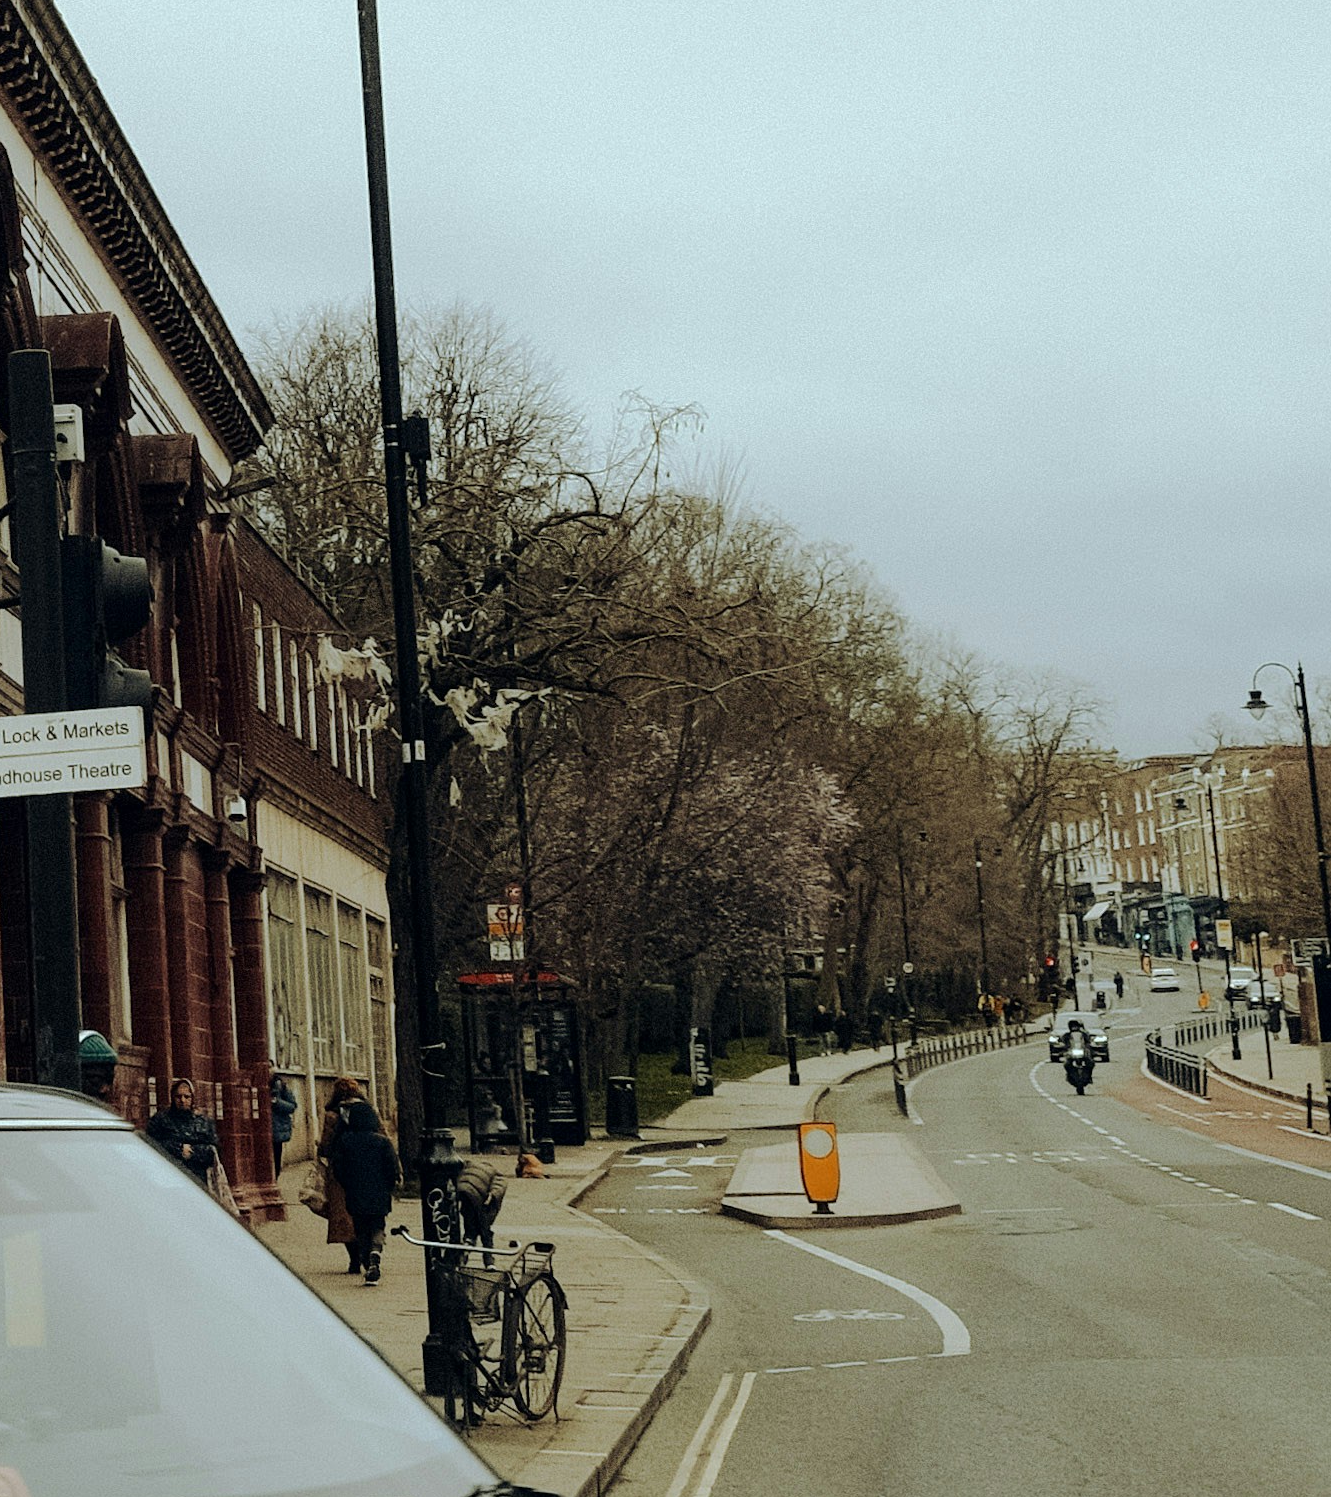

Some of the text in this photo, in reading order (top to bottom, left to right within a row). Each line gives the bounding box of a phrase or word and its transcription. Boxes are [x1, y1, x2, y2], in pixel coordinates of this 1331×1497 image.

[3, 727, 41, 745] Lock
[46, 724, 58, 741] &
[63, 720, 130, 740] Markets
[67, 762, 132, 780] Theatre
